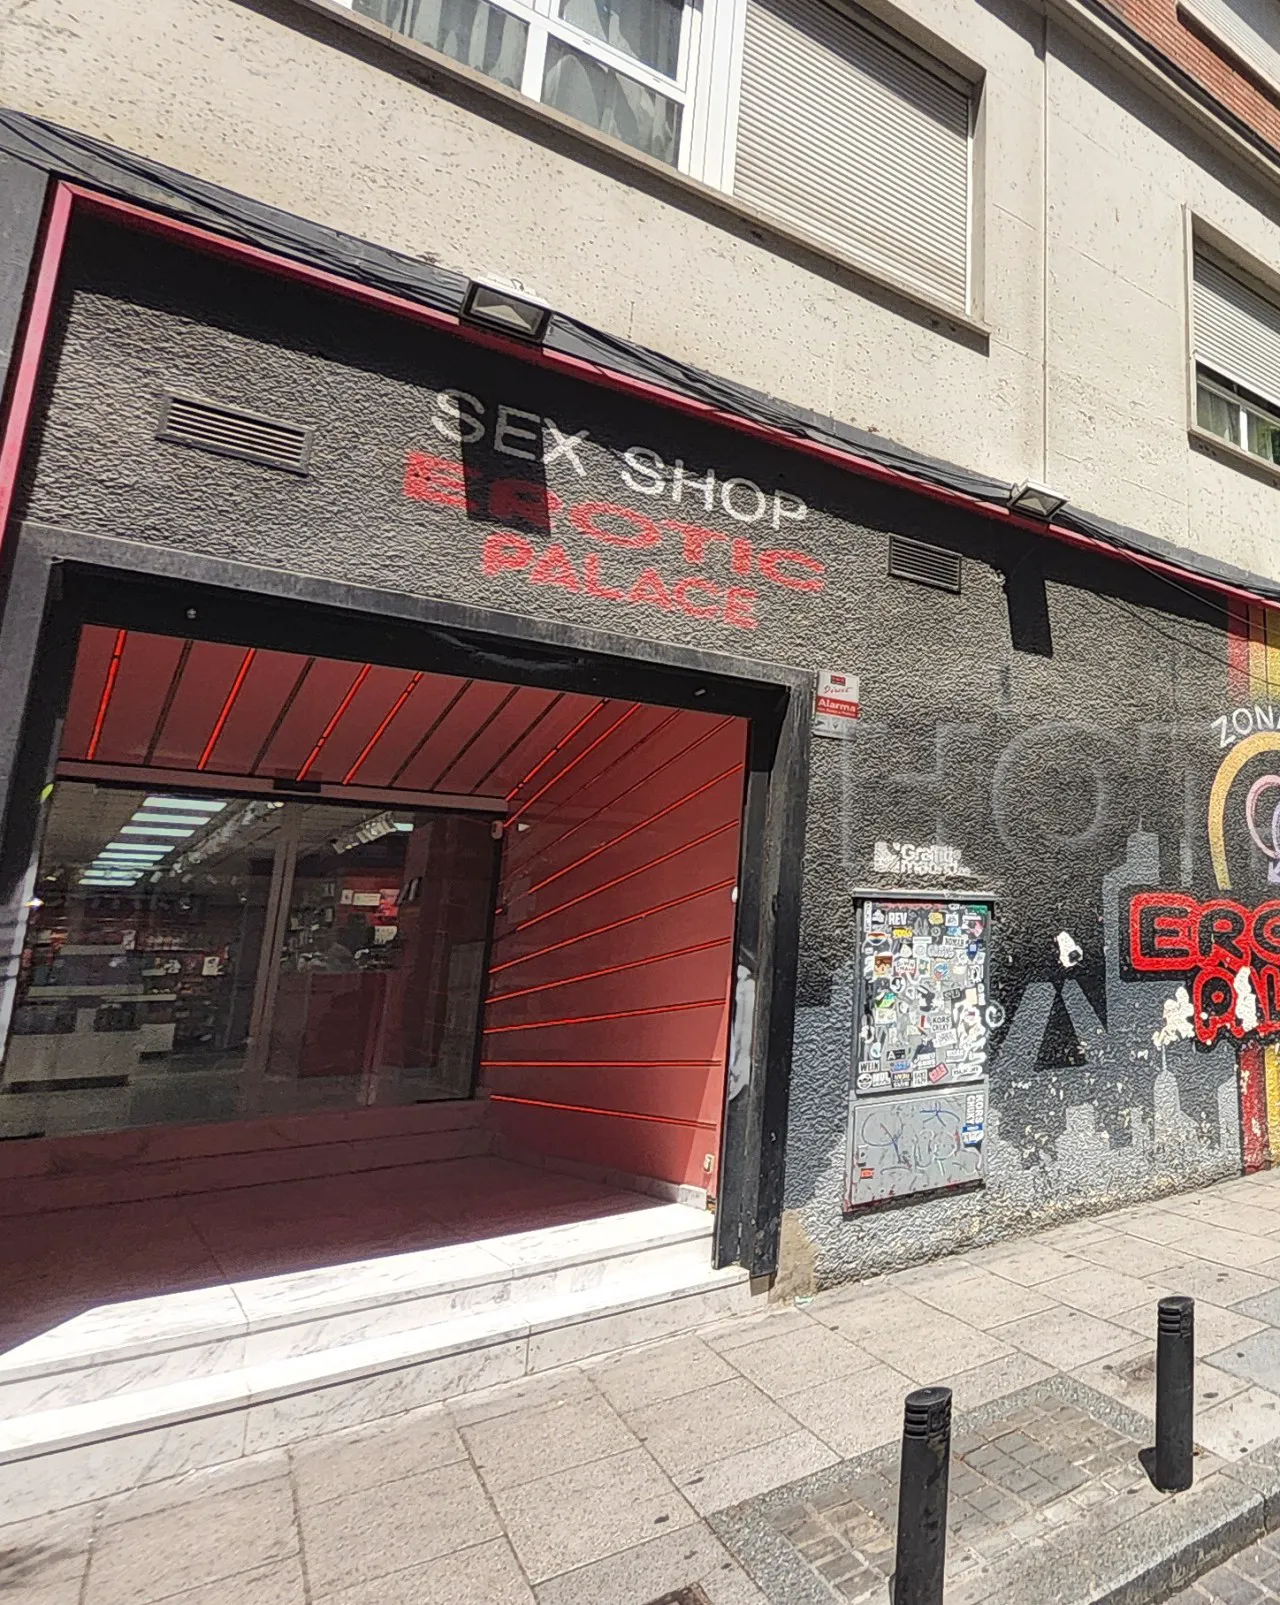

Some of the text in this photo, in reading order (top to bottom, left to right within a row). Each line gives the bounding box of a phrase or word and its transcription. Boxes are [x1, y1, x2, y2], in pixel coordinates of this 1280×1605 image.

[432, 388, 808, 530] SEX SHOP
[402, 451, 827, 592] EROTIC
[483, 532, 758, 630] PALACE
[818, 698, 856, 713] Alarma
[888, 912, 908, 926] REV
[976, 1094, 985, 1124] KORS
